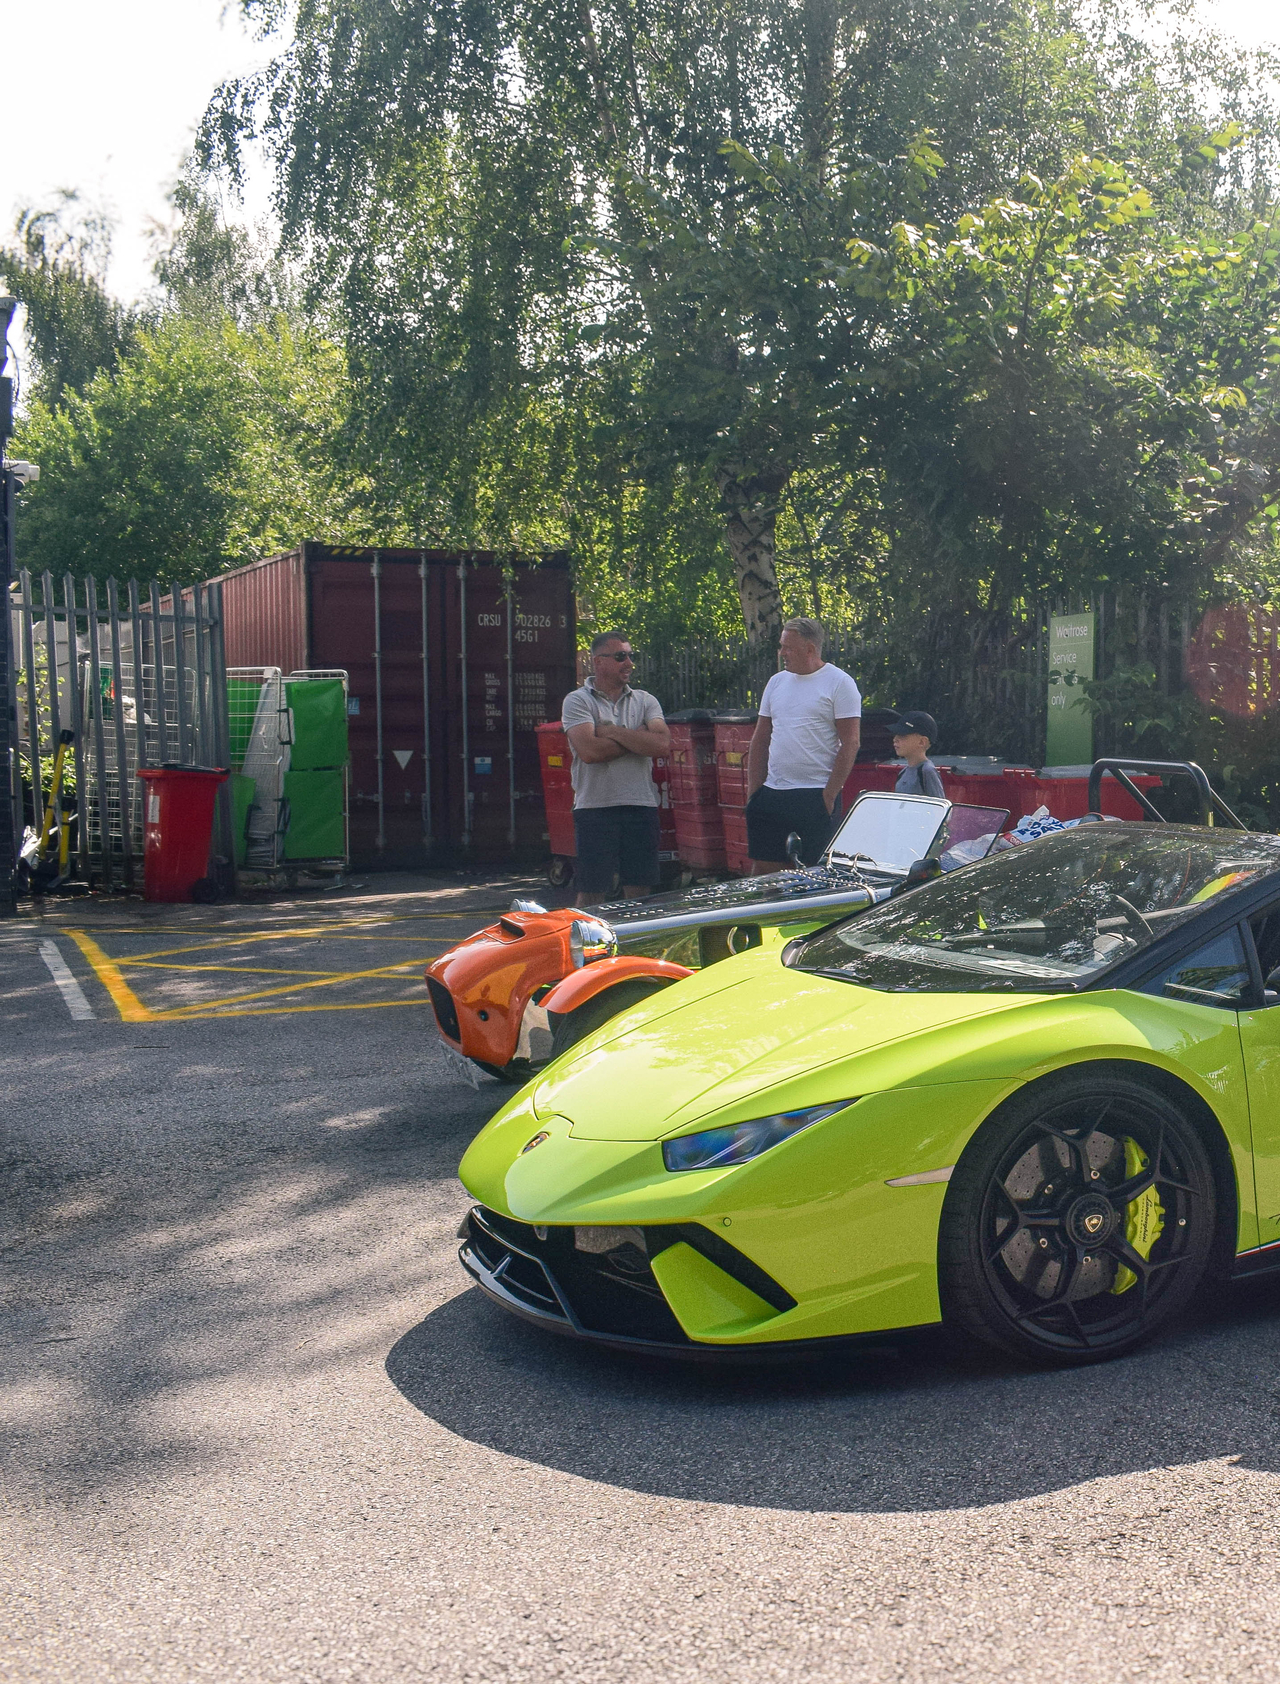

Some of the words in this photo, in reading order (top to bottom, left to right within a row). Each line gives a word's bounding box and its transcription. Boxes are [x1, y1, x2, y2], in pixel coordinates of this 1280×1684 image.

[478, 614, 501, 627] CRSU
[515, 615, 551, 628] 902826
[560, 615, 568, 628] 3
[515, 630, 539, 642] 45G1
[1056, 624, 1088, 639] Waitrose
[1052, 652, 1077, 665] Service
[1051, 692, 1066, 709] only
[1142, 1194, 1153, 1243] Lamborghini
